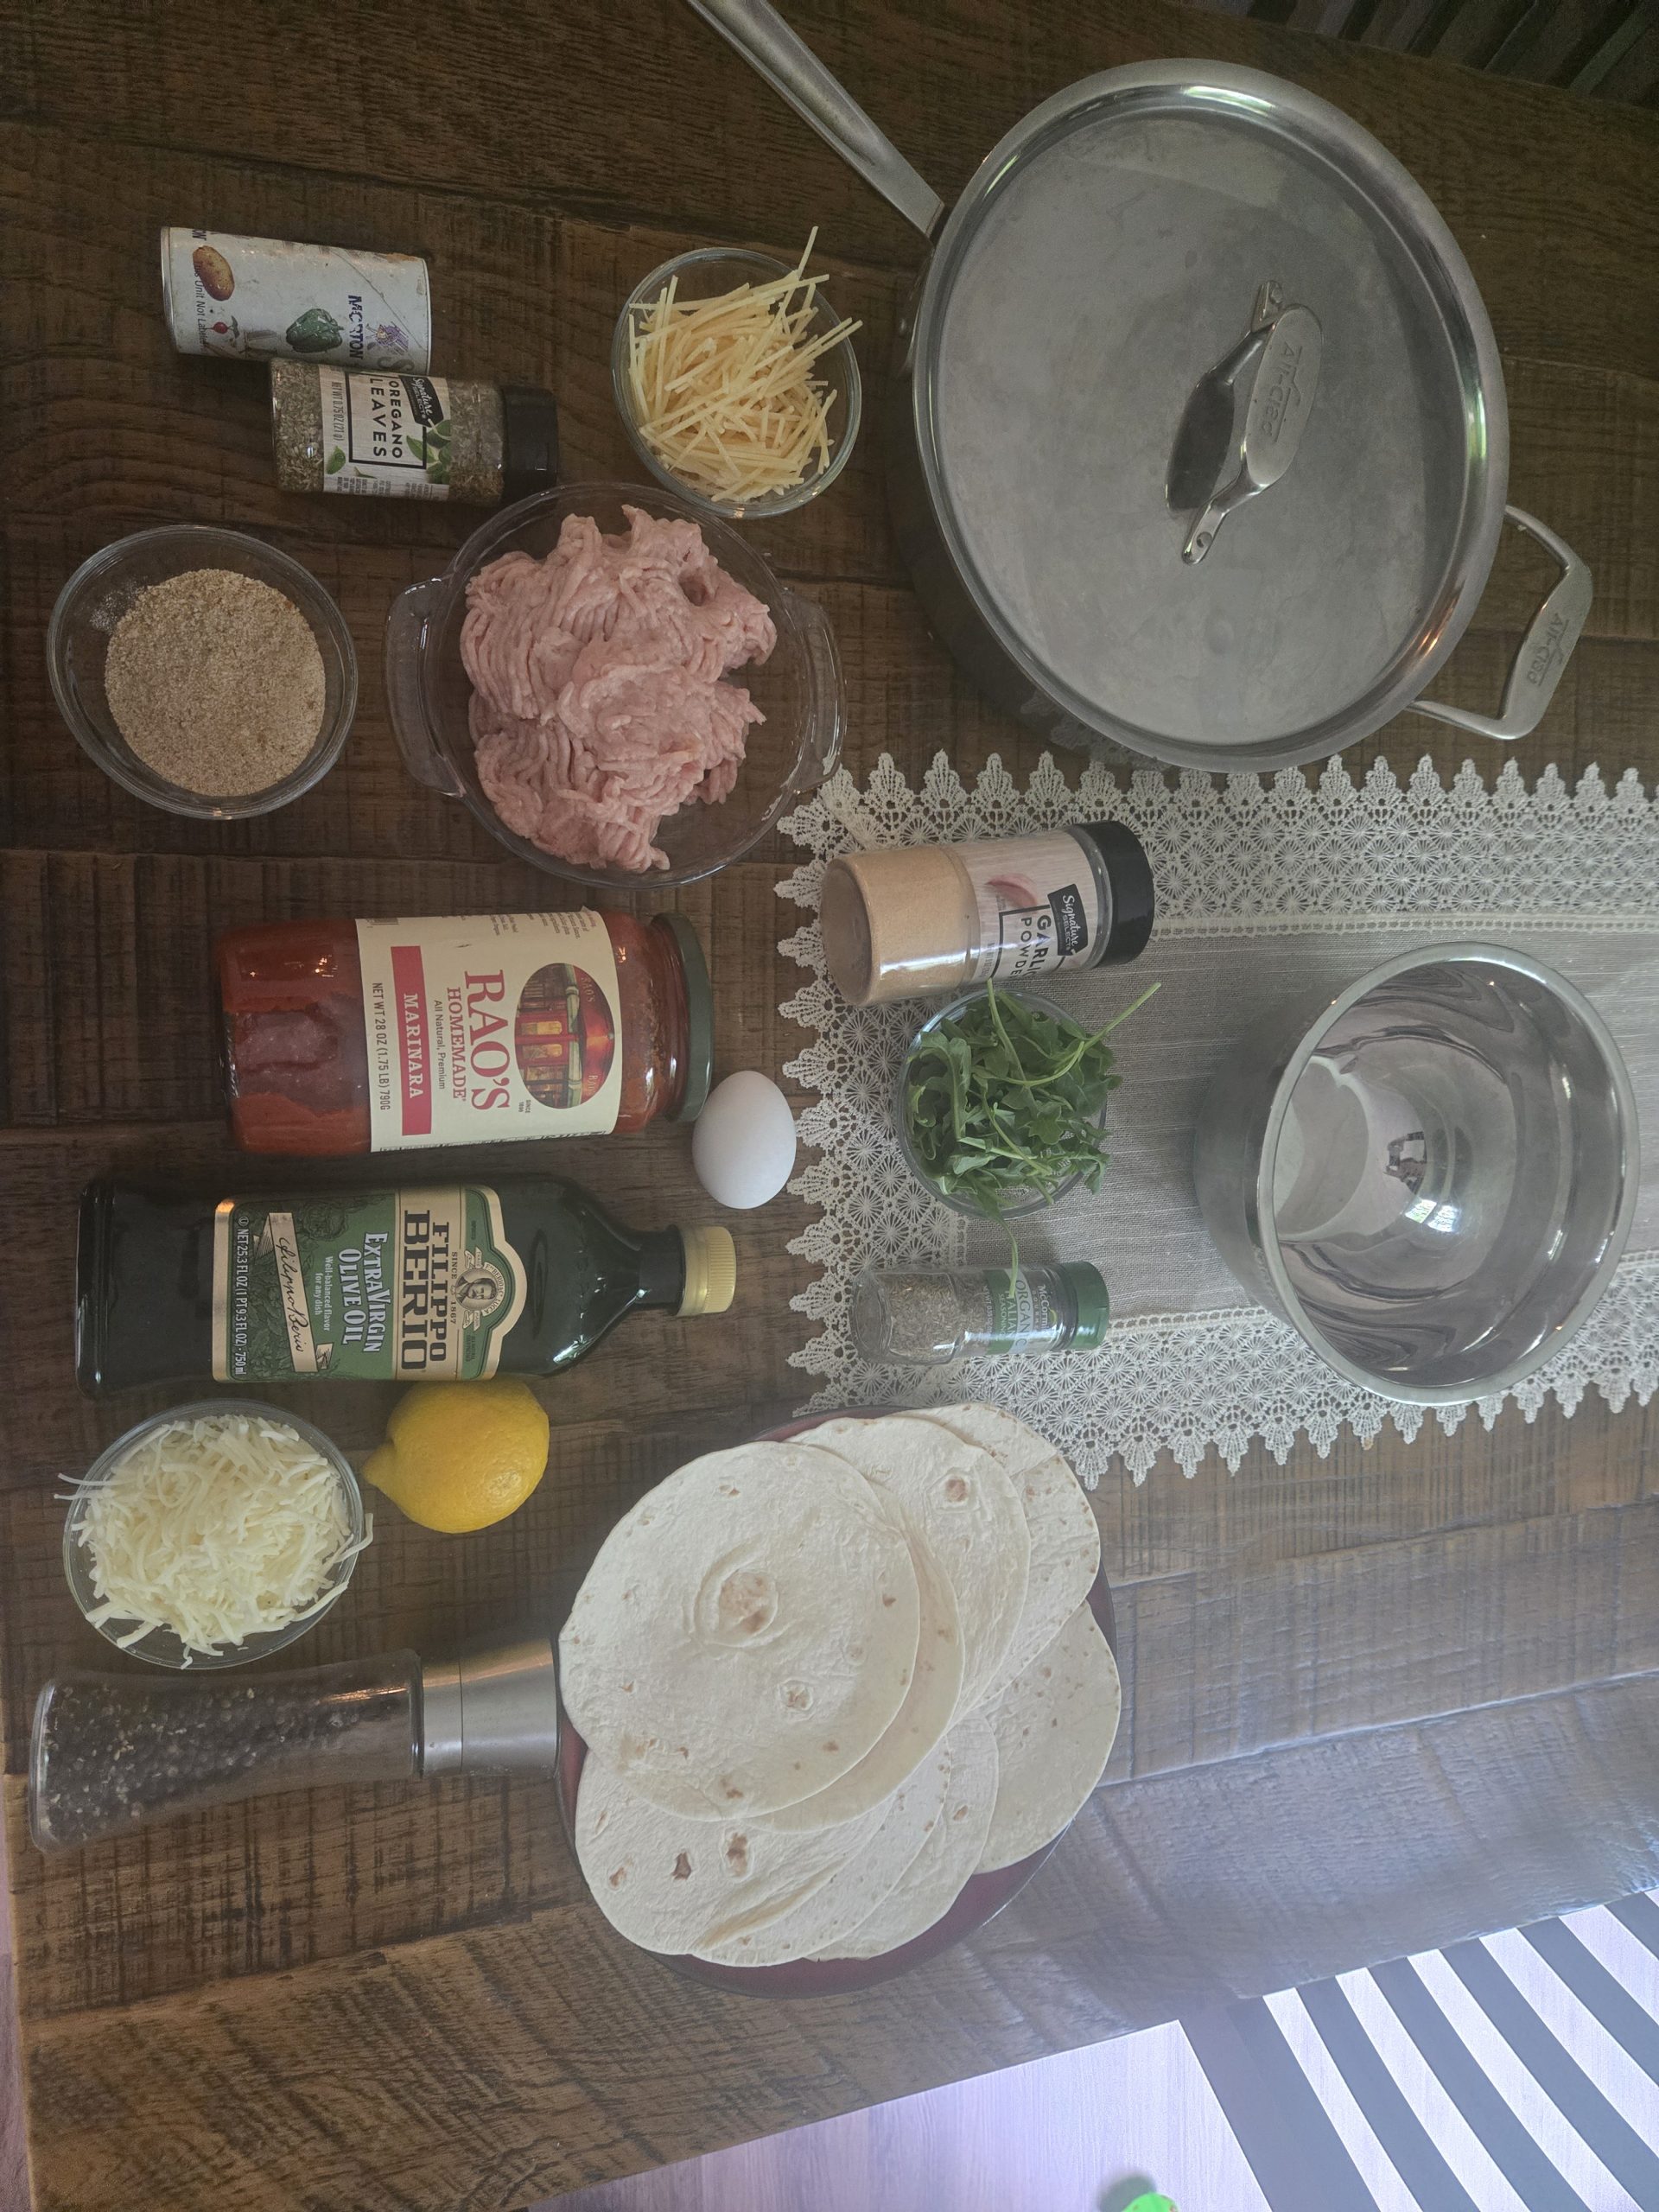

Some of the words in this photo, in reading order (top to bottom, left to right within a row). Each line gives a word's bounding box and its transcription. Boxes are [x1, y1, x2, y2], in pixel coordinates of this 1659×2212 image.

[194, 280, 205, 299] Unit
[195, 301, 206, 316] Not
[332, 382, 342, 391] NET
[332, 391, 342, 399] WT
[1262, 342, 1294, 435] All-Clad
[332, 401, 344, 413] 0.75
[411, 378, 434, 416] Signature
[413, 387, 424, 415] SELECT
[370, 378, 387, 456] LEAVES
[389, 380, 403, 458] OREGANO
[1527, 613, 1564, 684] All-Clad
[1061, 895, 1082, 947] Signature
[1062, 914, 1071, 947] SELECT
[1010, 918, 1032, 976] POWDE
[1022, 915, 1052, 976] GARLIC
[372, 982, 384, 999] NET
[373, 1002, 385, 1016] WT
[434, 1000, 442, 1012] All
[375, 1019, 386, 1030] 28
[435, 1014, 445, 1051] Natural,
[376, 1033, 387, 1046] OZ
[404, 994, 423, 1099] MARINARA
[448, 987, 467, 1100] HOMEMADE
[465, 969, 510, 1110] RAO'S
[376, 1047, 389, 1070] (1.75
[378, 1073, 390, 1088] LB)
[437, 1052, 446, 1090] Premium
[379, 1090, 391, 1110] 790G
[237, 1229, 247, 1245] NET
[236, 1245, 247, 1263] 25.3
[237, 1265, 247, 1275] FL
[315, 1272, 323, 1286] for
[338, 1248, 363, 1306] OLIVE
[490, 1269, 505, 1287] BERIO
[236, 1275, 247, 1287] OZ
[323, 1256, 334, 1308] Well-balanced
[401, 1210, 430, 1370] BERIO
[313, 1286, 321, 1298] any
[429, 1222, 449, 1362] FILIPPO
[235, 1298, 247, 1308] PT
[484, 1299, 501, 1313] LUCCA
[1037, 1285, 1049, 1329] McCormi
[235, 1308, 247, 1321] 9.3
[323, 1308, 332, 1331] flavor
[1014, 1281, 1031, 1346] ORGANC
[235, 1324, 246, 1332] FL
[341, 1309, 366, 1344] OIL
[235, 1333, 247, 1346] OZ)
[235, 1352, 246, 1366] 750
